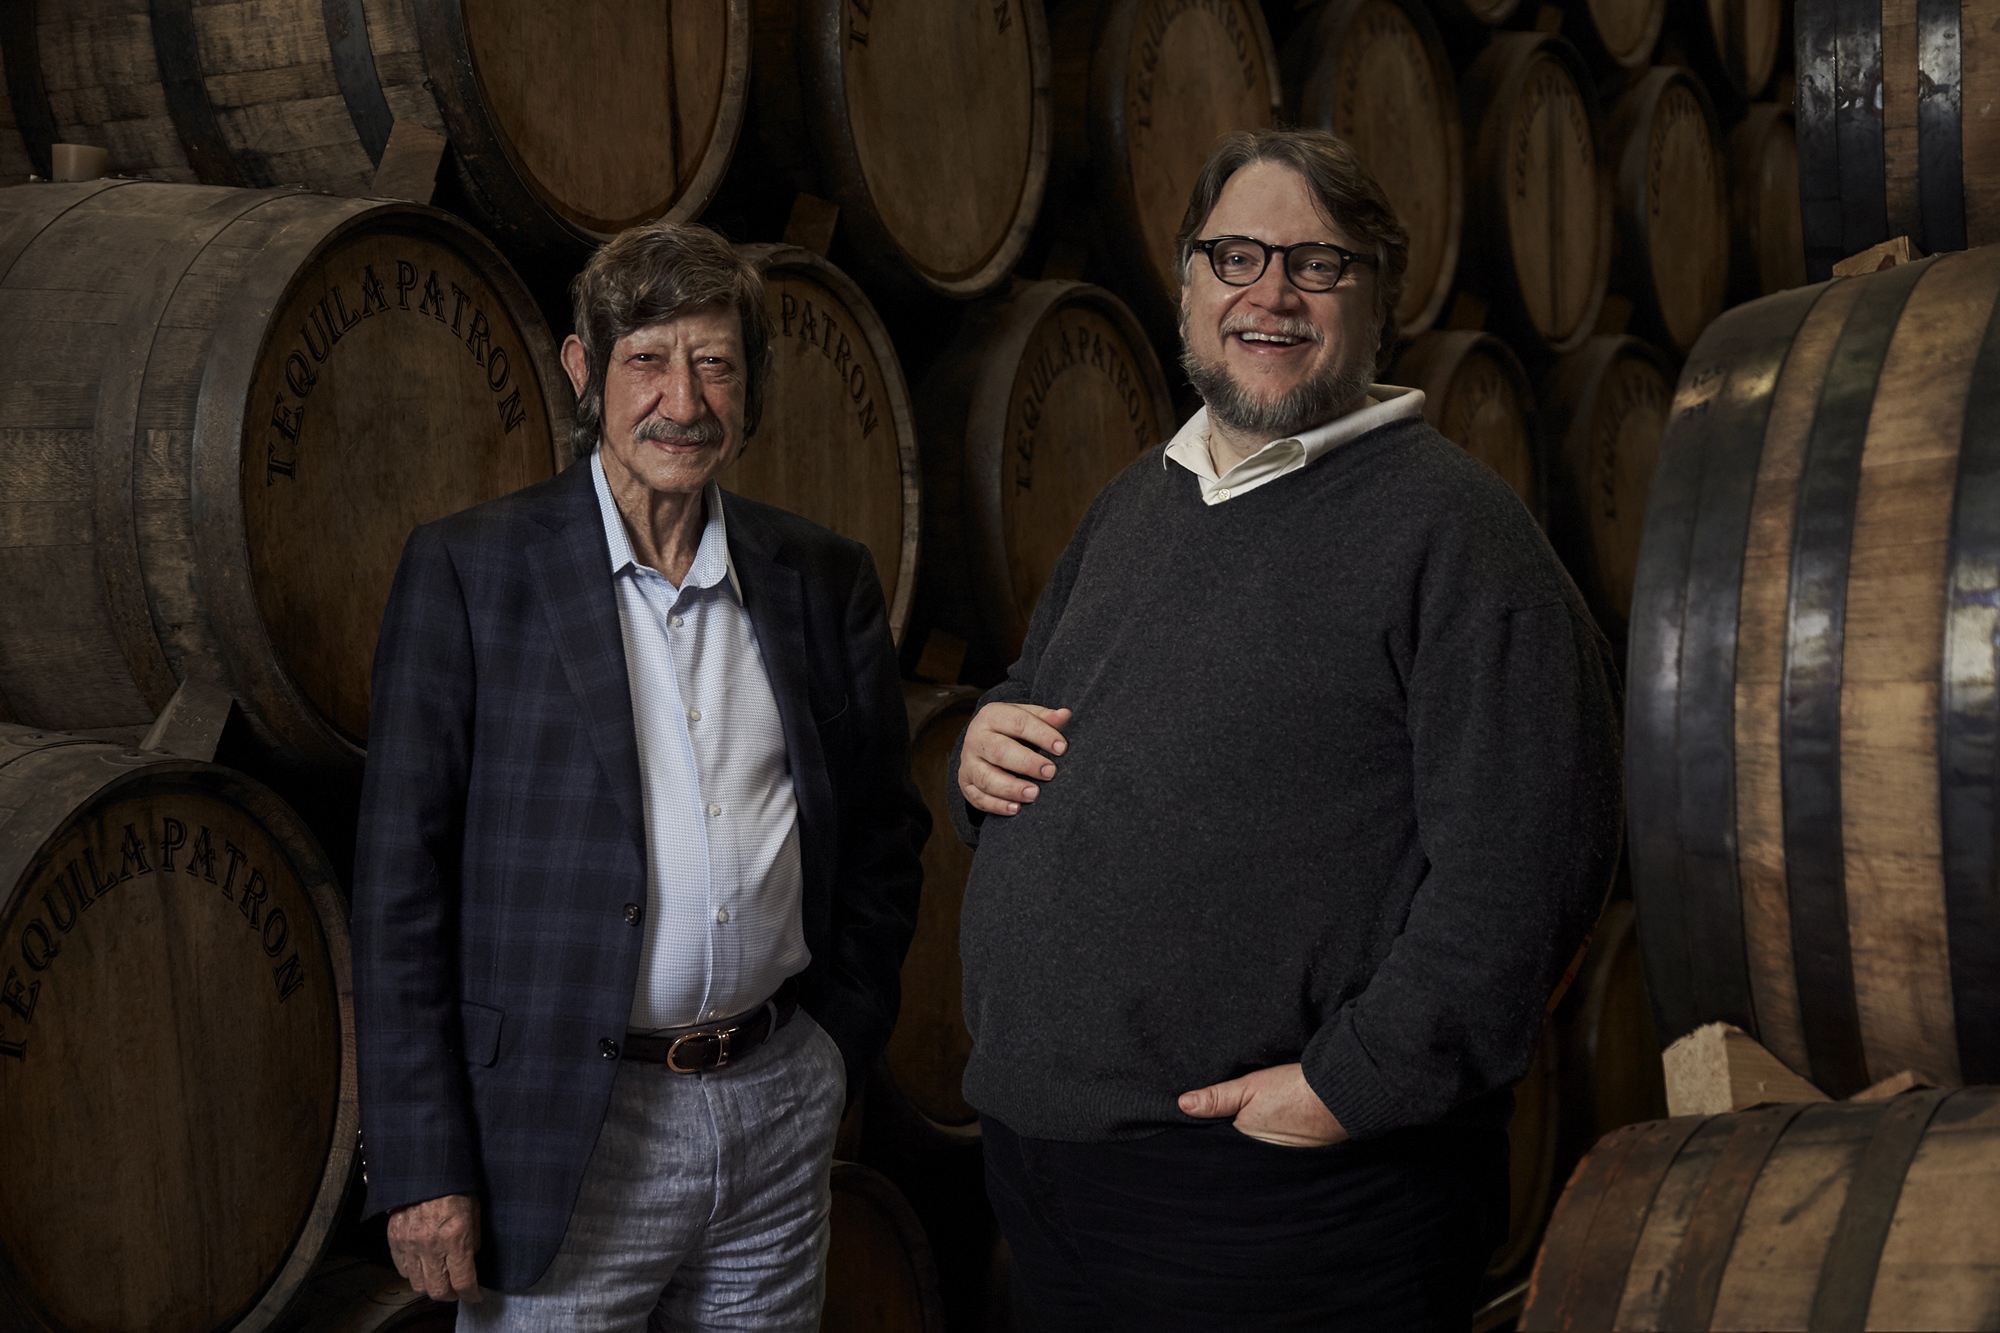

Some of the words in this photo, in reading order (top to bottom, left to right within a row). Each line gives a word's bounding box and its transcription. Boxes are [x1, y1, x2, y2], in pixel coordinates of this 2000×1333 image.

[267, 264, 391, 487] TEQUILA
[396, 259, 526, 435] PATRON
[781, 293, 878, 439] PATRON
[1015, 330, 1077, 496] TEQUILA
[1078, 325, 1150, 451] PATRON
[161, 817, 304, 1004] PATRON
